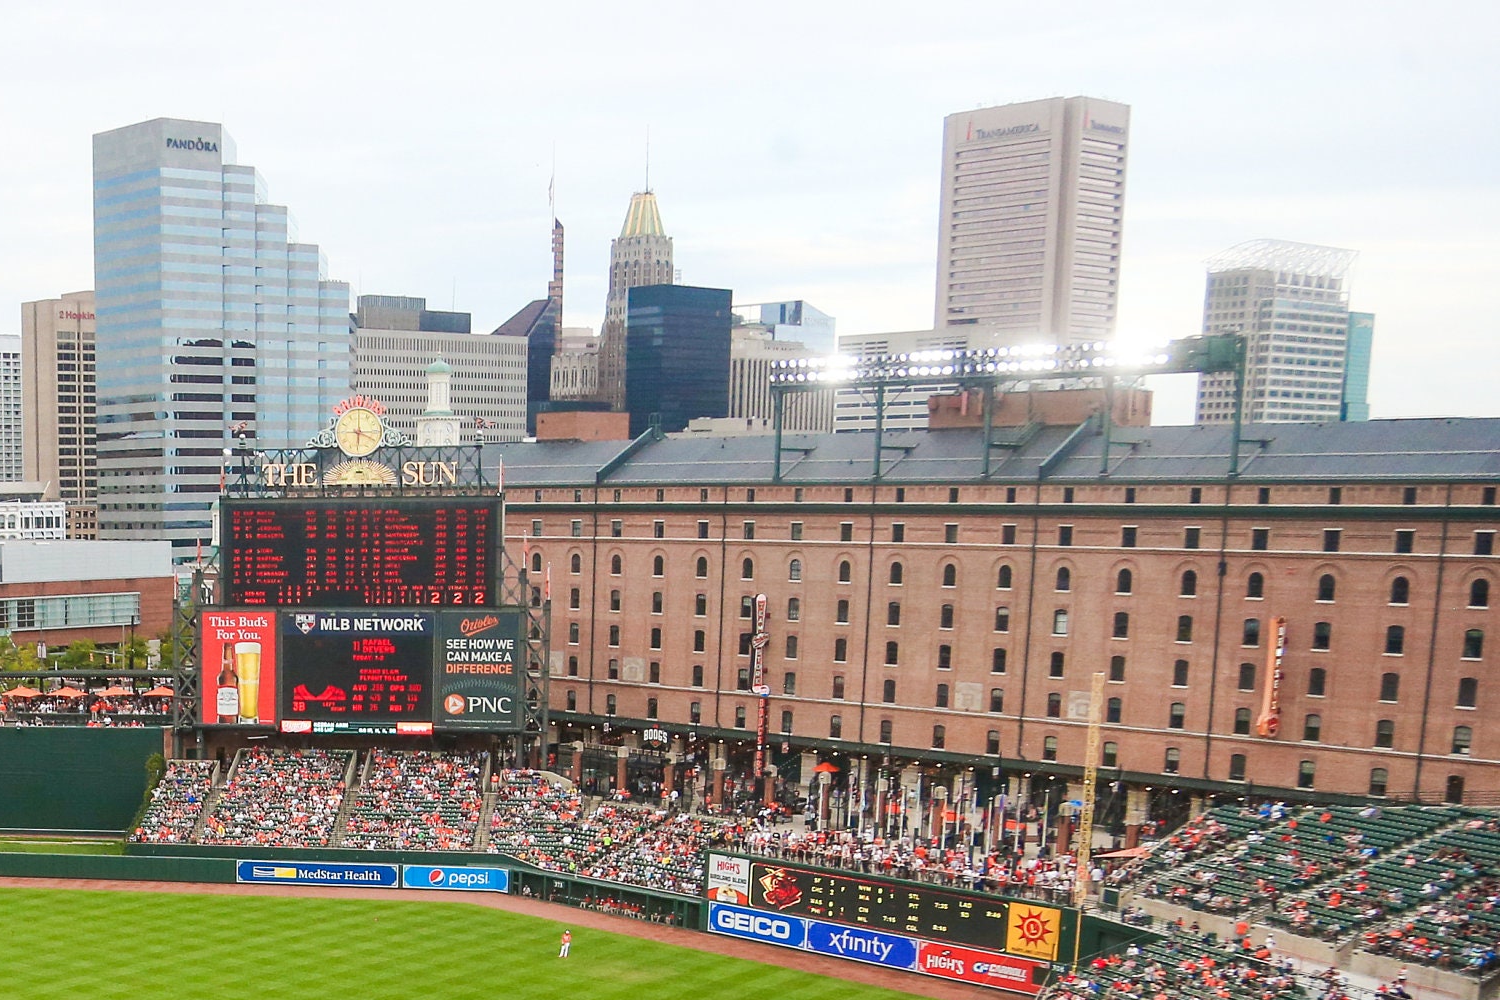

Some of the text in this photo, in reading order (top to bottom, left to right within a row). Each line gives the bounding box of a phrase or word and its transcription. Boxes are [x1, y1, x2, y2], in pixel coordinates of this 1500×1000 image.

[66, 310, 95, 320] Hopkin
[262, 461, 458, 486] THE SUN
[431, 592, 484, 604] 2 2 2
[208, 616, 268, 627] This Bud's
[320, 618, 424, 631] MLB NETWORK
[460, 614, 499, 635] Orioles
[216, 629, 261, 640] For You.
[353, 641, 360, 651] 11
[446, 639, 514, 649] SEE HOW WE
[446, 651, 512, 662] CAN MAKE A
[445, 663, 513, 674] DIFFERENCE
[352, 684, 367, 692] AVG
[293, 701, 307, 712] 3B
[467, 696, 512, 714] PNC
[298, 868, 381, 881] MedStar Health
[448, 871, 489, 886] pepsi
[717, 909, 790, 939] GEICO
[829, 929, 894, 962] xfinity
[926, 954, 965, 976] HIGH'S
